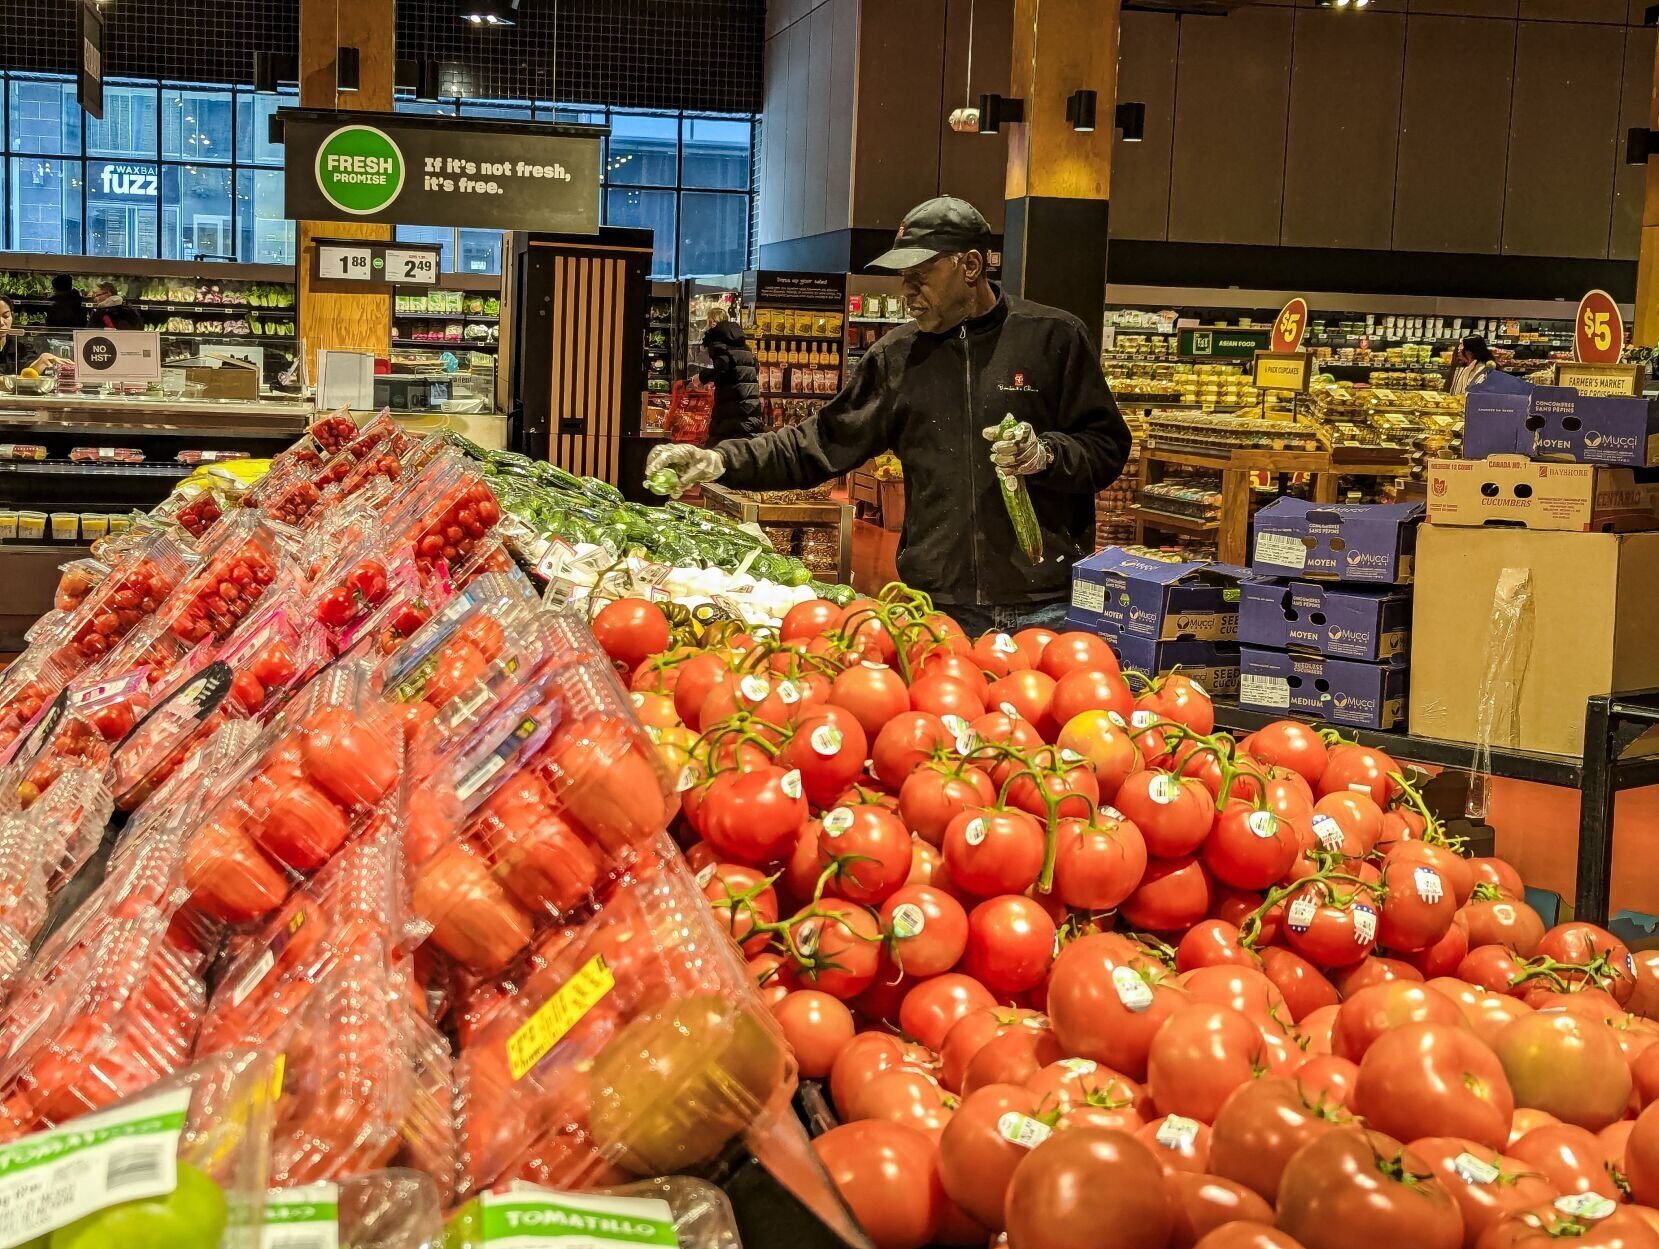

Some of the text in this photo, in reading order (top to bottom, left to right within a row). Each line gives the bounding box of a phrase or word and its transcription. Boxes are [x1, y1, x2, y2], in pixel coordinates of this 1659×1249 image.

[327, 154, 393, 174] FRESH
[425, 157, 571, 182] If it's not fresh,
[116, 165, 158, 175] WAXBA
[101, 164, 158, 196] fuzz
[333, 172, 387, 185] PROMISE
[424, 175, 504, 194] it's free.
[1280, 310, 1301, 343] $5
[1583, 307, 1612, 351] $5
[92, 345, 107, 353] NO
[1568, 377, 1625, 390] FARMER'S MARKET
[1536, 438, 1571, 449] MOYEN
[1601, 434, 1638, 446] Mucci
[1488, 461, 1511, 469] CANADA
[1549, 467, 1588, 477] BAYSHORE
[1481, 497, 1532, 508] CUCUMBERS
[1307, 558, 1337, 567] MOYEN
[1360, 553, 1389, 564] Mucci
[1103, 609, 1124, 619] MOYEN
[1189, 618, 1216, 628] Mucci
[1289, 629, 1318, 641] MOYEN
[1341, 629, 1370, 641] Mucci
[1293, 662, 1323, 671] SEEDLESS
[1213, 669, 1240, 680] SEED
[1291, 697, 1324, 708] MEDIUM
[1346, 696, 1375, 708] Mucci
[506, 1210, 656, 1237] TOMATILLO
